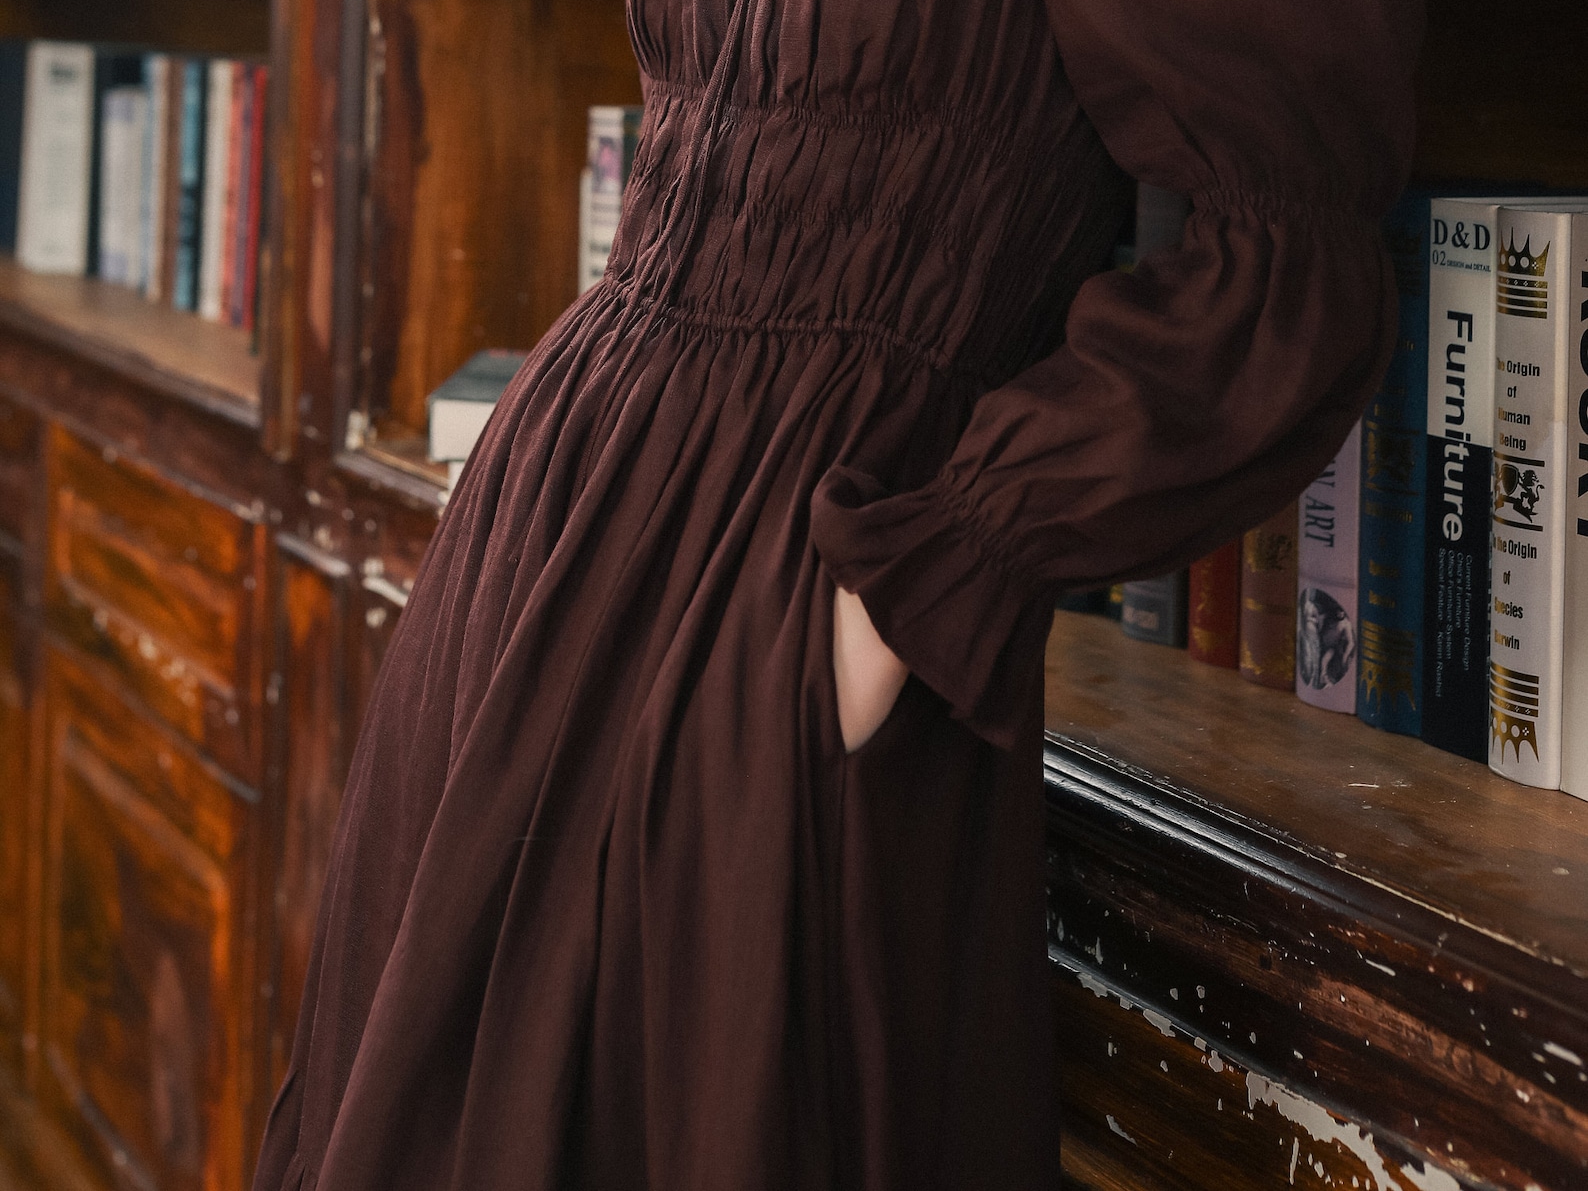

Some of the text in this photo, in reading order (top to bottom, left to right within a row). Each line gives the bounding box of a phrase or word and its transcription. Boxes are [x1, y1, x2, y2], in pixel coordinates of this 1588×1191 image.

[1431, 249, 1447, 267] 02
[1473, 263, 1492, 272] DETAIL
[1506, 360, 1540, 377] Origin
[1507, 386, 1517, 398] of
[1442, 310, 1474, 542] Furniture
[1498, 407, 1531, 425] Human
[1499, 432, 1527, 451] Being
[1304, 495, 1336, 548] ART
[1508, 539, 1538, 559] Origin
[1438, 547, 1447, 582] Special
[1503, 570, 1511, 585] of
[1437, 585, 1446, 620] Feature
[1445, 550, 1455, 659] Office Furniture System
[1455, 586, 1463, 628] Furniture
[1461, 554, 1472, 671] Current Furniture Design
